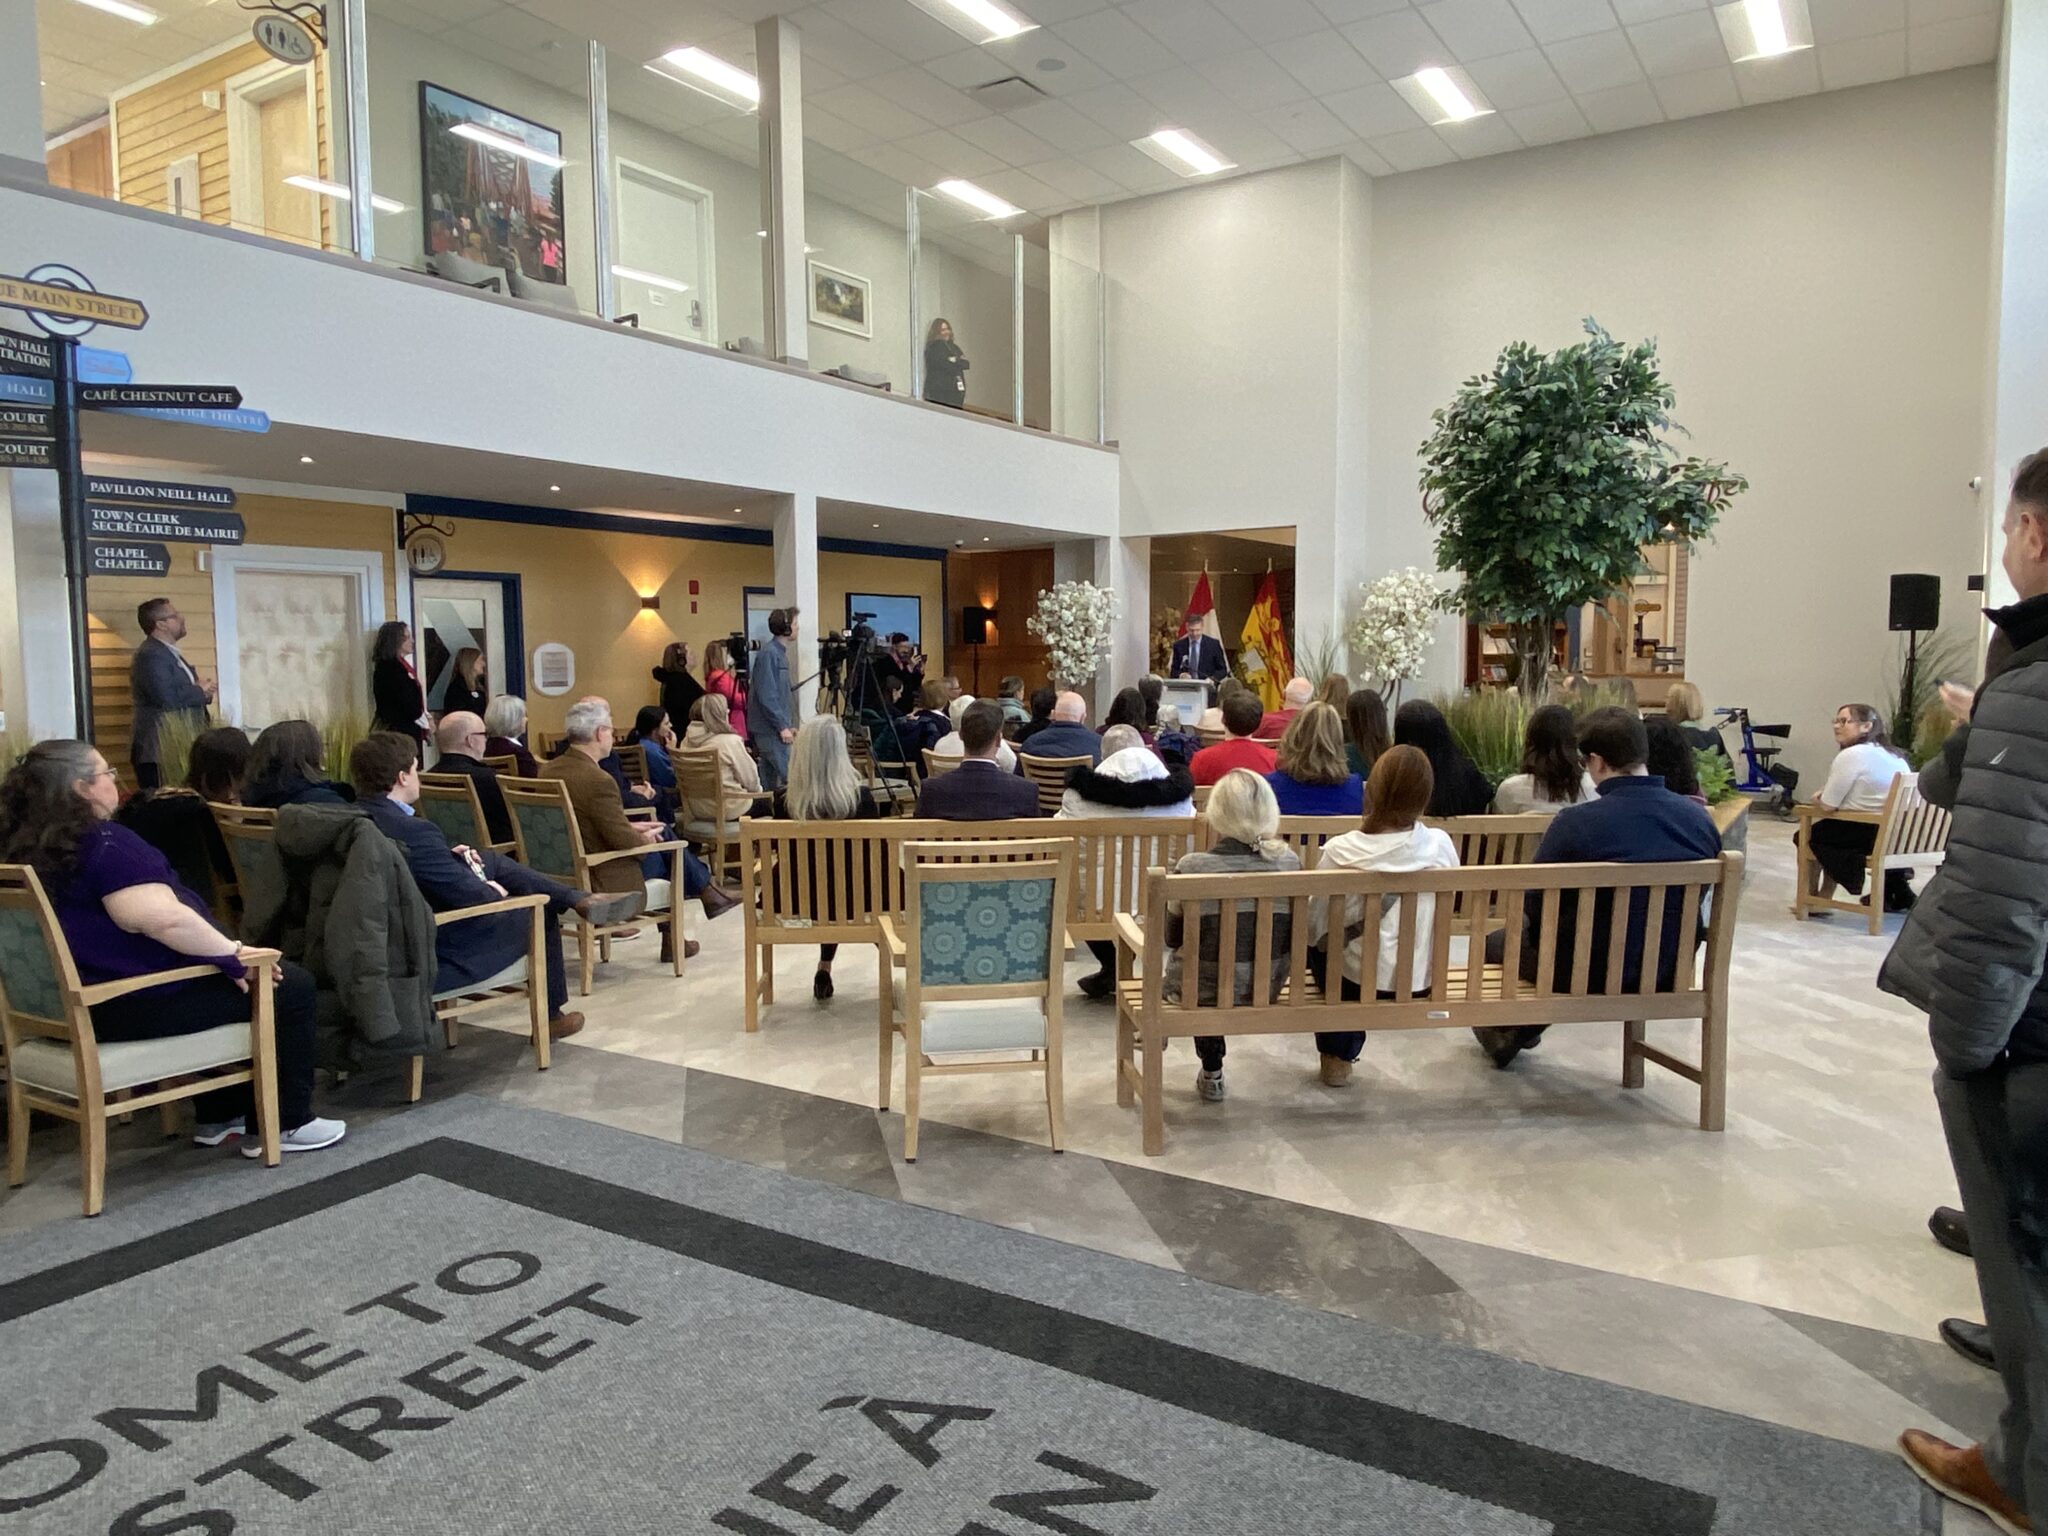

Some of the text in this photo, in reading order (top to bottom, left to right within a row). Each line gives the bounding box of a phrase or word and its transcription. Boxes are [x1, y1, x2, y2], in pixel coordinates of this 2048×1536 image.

[22, 287, 71, 308] MAIN
[75, 299, 139, 320] STREET
[20, 340, 51, 356] HALL
[8, 383, 47, 397] HALL
[83, 389, 118, 401] CAFÉ
[120, 391, 199, 402] CHESTNUT
[90, 482, 231, 503] PAVILLON NEILL HALL
[91, 509, 180, 525] TOWN CLERK
[92, 521, 239, 540] SECRÉTAIRE DE MAIRIE
[94, 547, 149, 559] CHAPEL
[95, 558, 164, 571] CHAPELLE
[343, 1250, 542, 1325] TO
[108, 1282, 643, 1536] STREET
